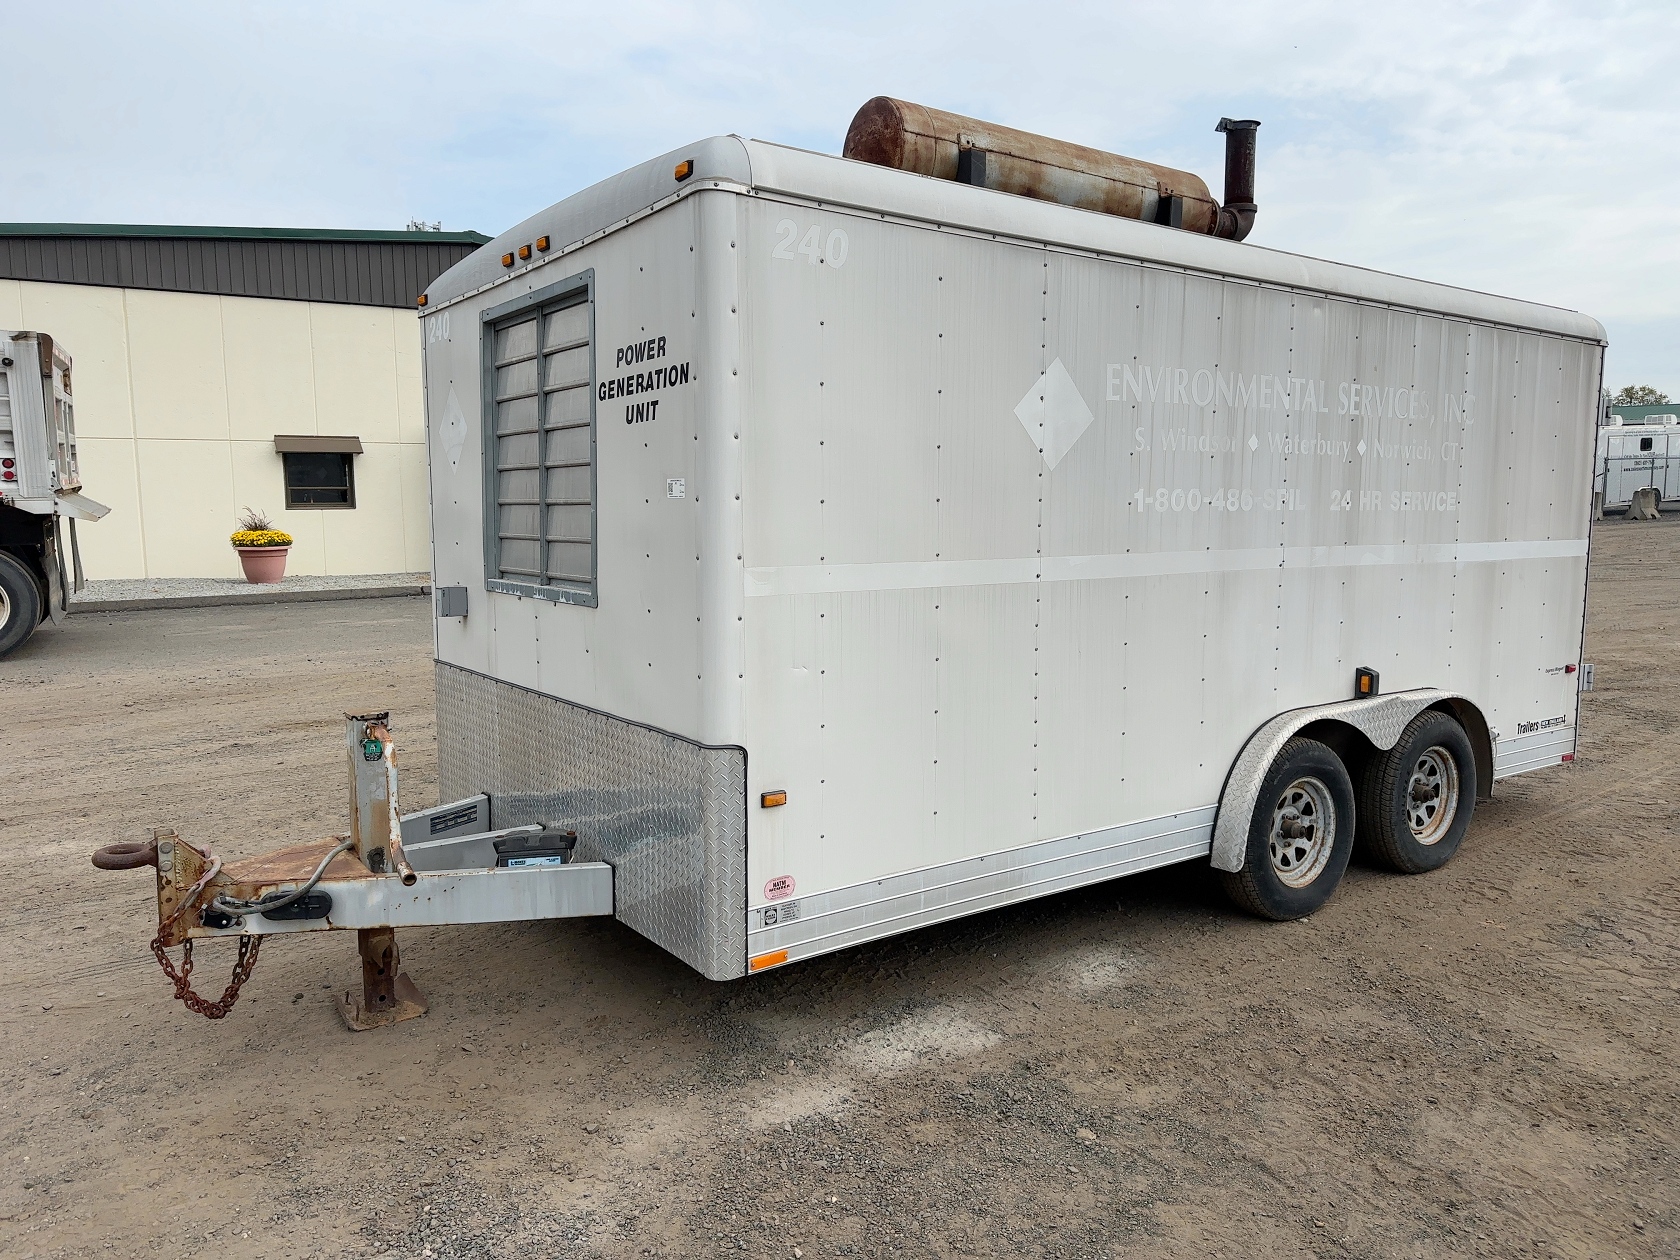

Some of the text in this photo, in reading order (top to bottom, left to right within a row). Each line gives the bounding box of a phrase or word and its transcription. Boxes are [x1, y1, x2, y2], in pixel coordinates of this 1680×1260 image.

[772, 218, 849, 269] 240
[430, 311, 450, 344] 240
[616, 336, 667, 368] POWER
[598, 362, 690, 401] GENERATION
[1105, 363, 1476, 428] ENVIRONMENTAL SERVICES, INC
[625, 400, 659, 425] UNIT
[1134, 426, 1459, 463] S. Windsor Waterbury Norwich, CT
[1330, 489, 1352, 511] 24
[1359, 490, 1382, 511] HR
[1390, 490, 1457, 511] SERVICE
[1517, 720, 1540, 735] Trailers
